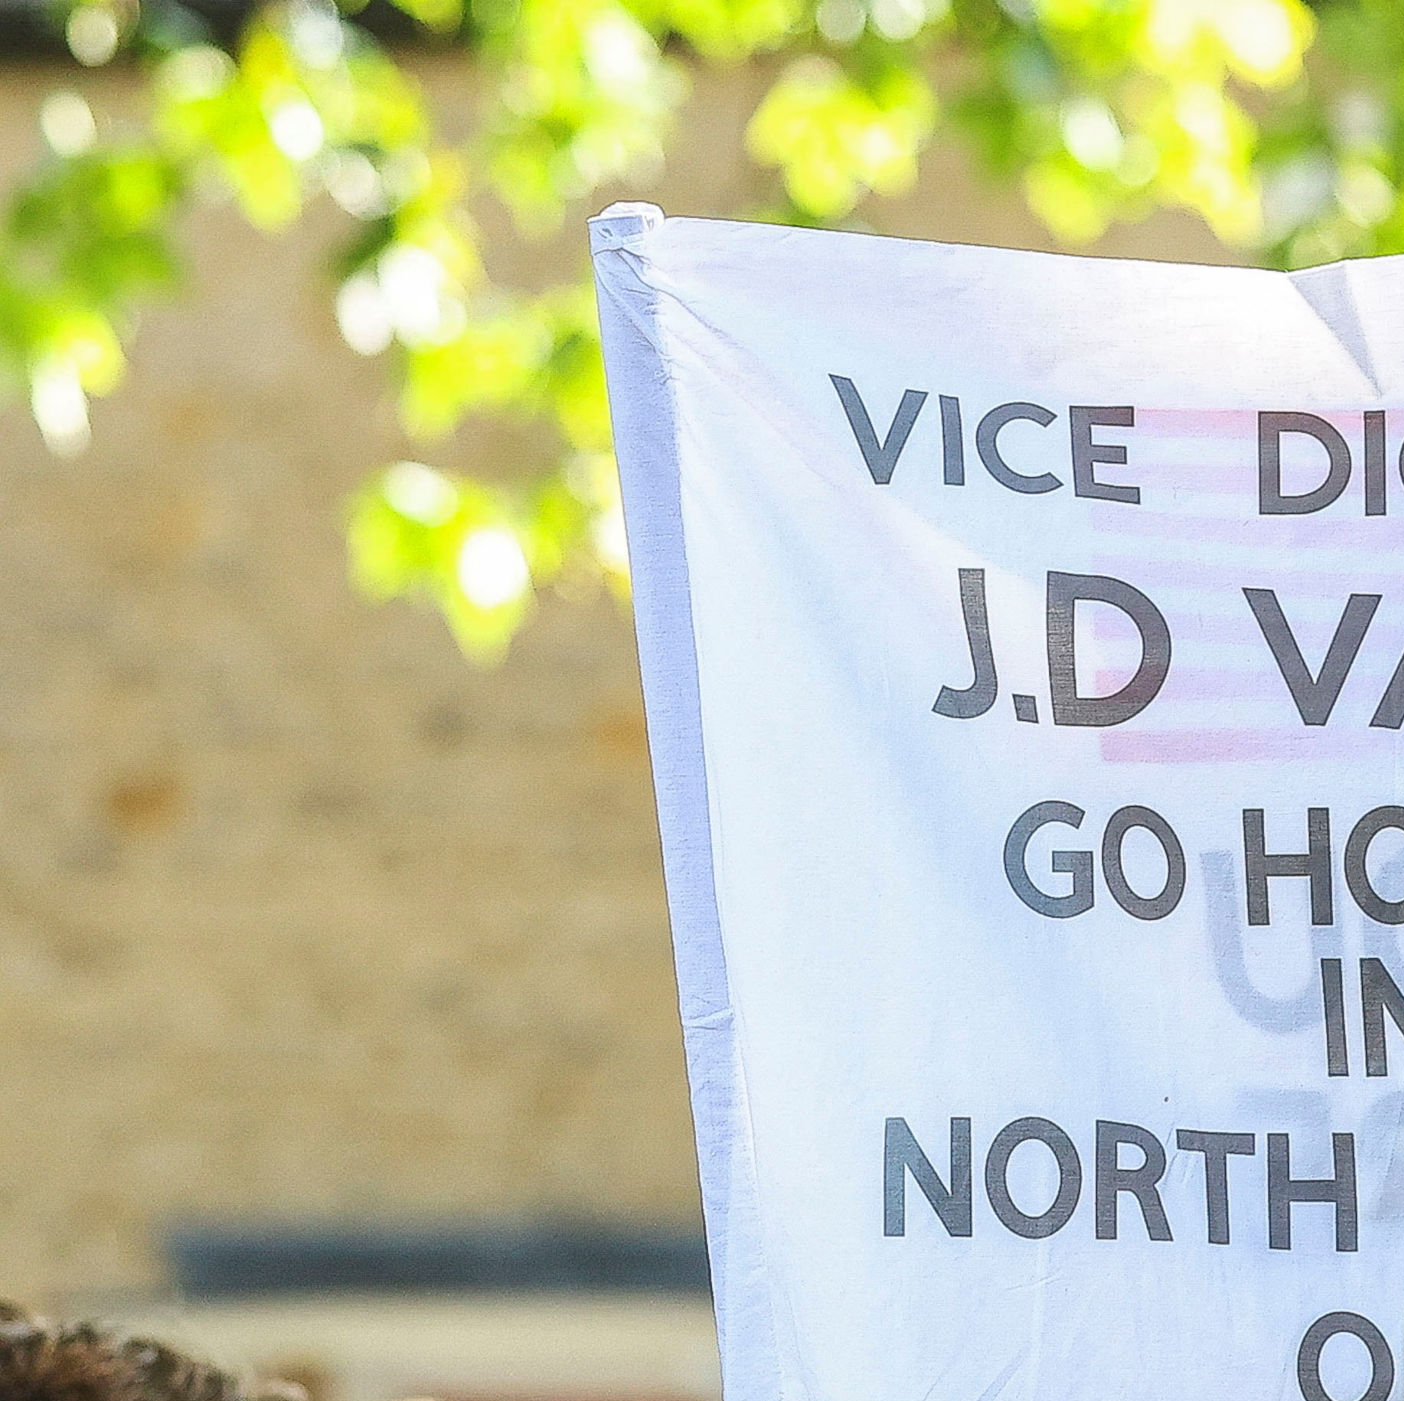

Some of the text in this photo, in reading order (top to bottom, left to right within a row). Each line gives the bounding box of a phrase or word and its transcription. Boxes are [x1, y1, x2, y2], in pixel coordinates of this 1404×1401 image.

[829, 373, 1142, 505] VICE
[932, 566, 1173, 728] J.D
[1002, 799, 1187, 921] GO
[883, 1116, 1359, 1253] NORTH
